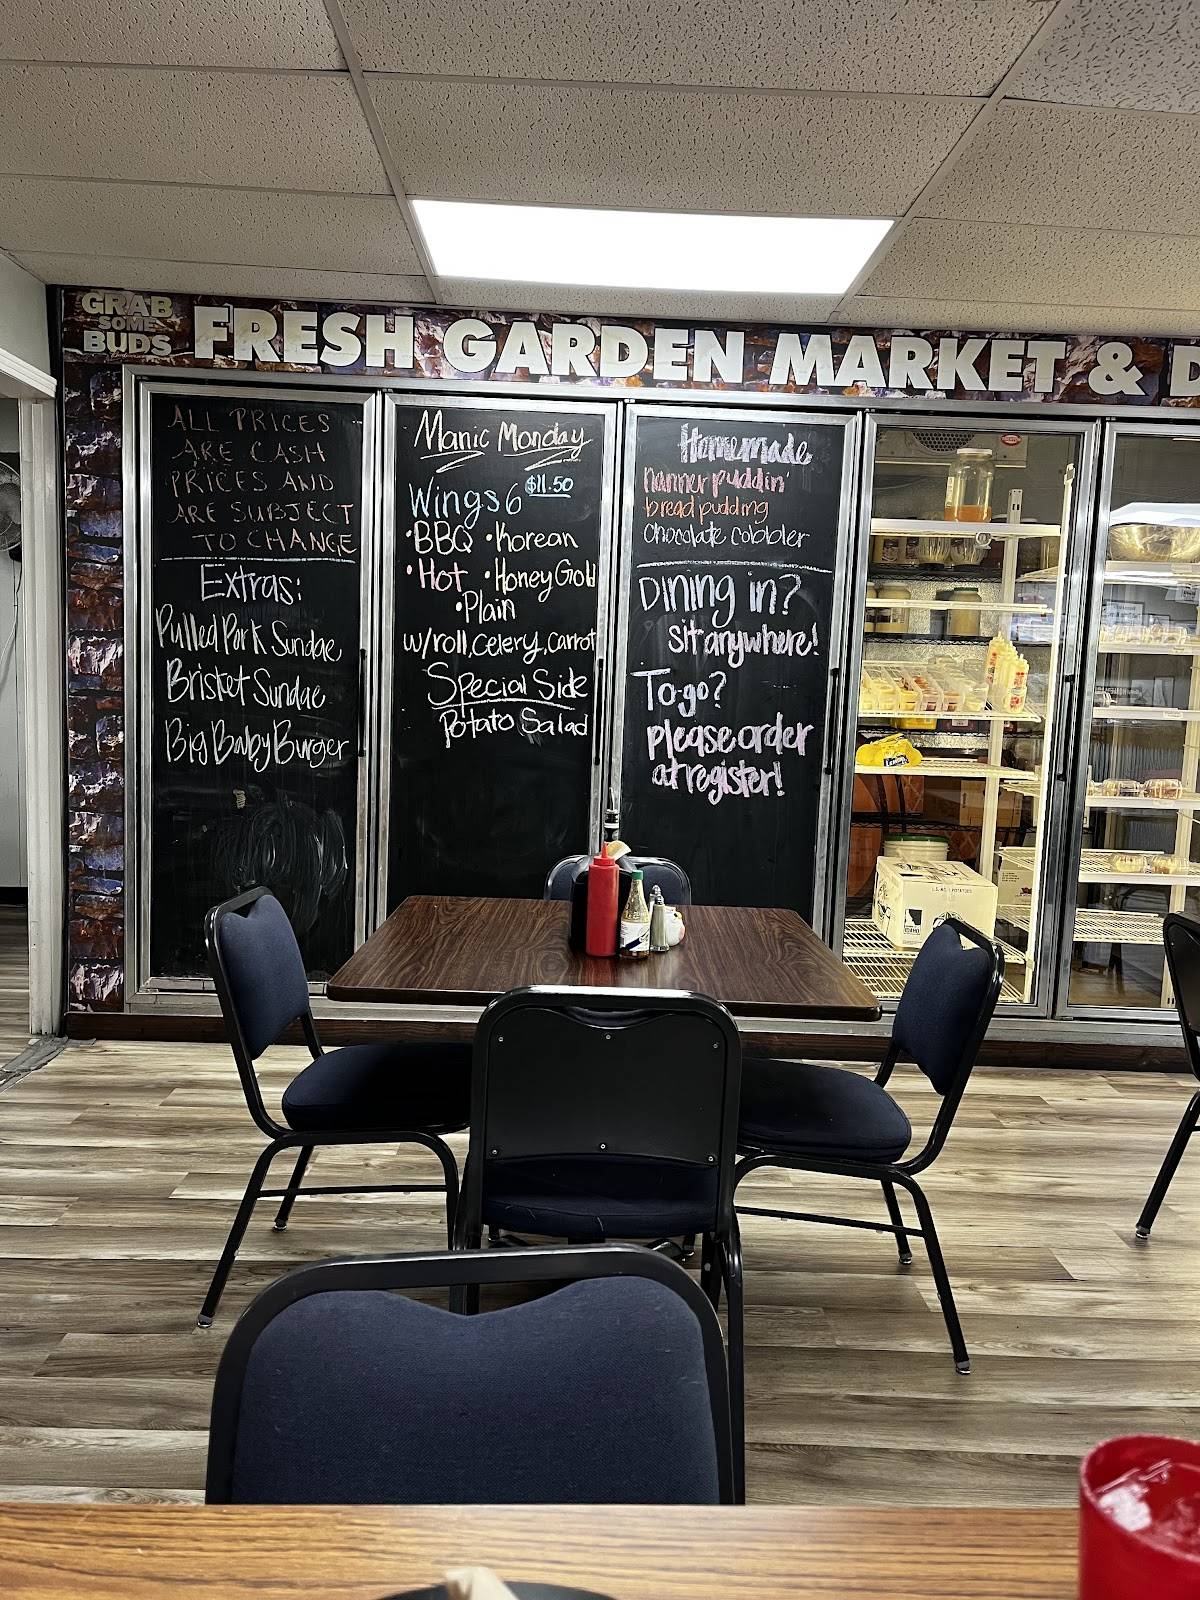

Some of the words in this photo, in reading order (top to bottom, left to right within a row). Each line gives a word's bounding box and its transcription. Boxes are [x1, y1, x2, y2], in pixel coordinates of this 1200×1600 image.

[82, 292, 173, 318] GRAB
[98, 315, 157, 332] SOME
[83, 330, 172, 356] BUDS
[193, 304, 415, 370] FRESH
[442, 317, 745, 383] GARDEN
[768, 332, 1067, 394] MARKET
[1087, 341, 1147, 397] &
[168, 404, 220, 432] ALL
[229, 408, 331, 434] PRICES
[414, 410, 490, 452] Manic
[497, 421, 593, 460] Monday
[171, 438, 233, 463] ARE
[249, 441, 329, 464] CASH
[678, 423, 813, 465] Homemade
[169, 468, 268, 498] PRICES
[281, 472, 336, 493] AND
[408, 476, 500, 530] Wings
[505, 483, 522, 515] 6
[525, 473, 574, 495] $11.50
[167, 501, 217, 524] ARE
[229, 502, 355, 525] SUBJECT
[645, 495, 695, 518] bread
[699, 495, 769, 525] pudding
[192, 532, 236, 552] TO
[246, 528, 357, 556] CHANGE
[414, 519, 474, 555] BBQ
[495, 521, 579, 553] Korean
[201, 563, 302, 605] Extras:
[418, 557, 468, 592] Hot
[495, 557, 553, 602] Honey
[555, 558, 597, 588] Gold
[747, 570, 802, 615] in?
[462, 589, 516, 625] Plain
[156, 603, 218, 653] Pulled
[222, 612, 268, 655] Pork
[270, 619, 342, 662] Sundae
[704, 621, 820, 668] anywhere!
[167, 657, 250, 707] Brisket
[253, 668, 326, 710] Sundae
[427, 661, 527, 718] Special
[533, 667, 588, 700] Side
[165, 717, 208, 766] Big
[211, 719, 271, 773] Baby
[273, 719, 349, 769] Burger
[440, 708, 515, 749] Potato
[521, 706, 589, 736] Salad
[646, 718, 736, 760] please
[736, 711, 815, 756] order
[652, 755, 687, 790] at
[685, 758, 785, 806] register!
